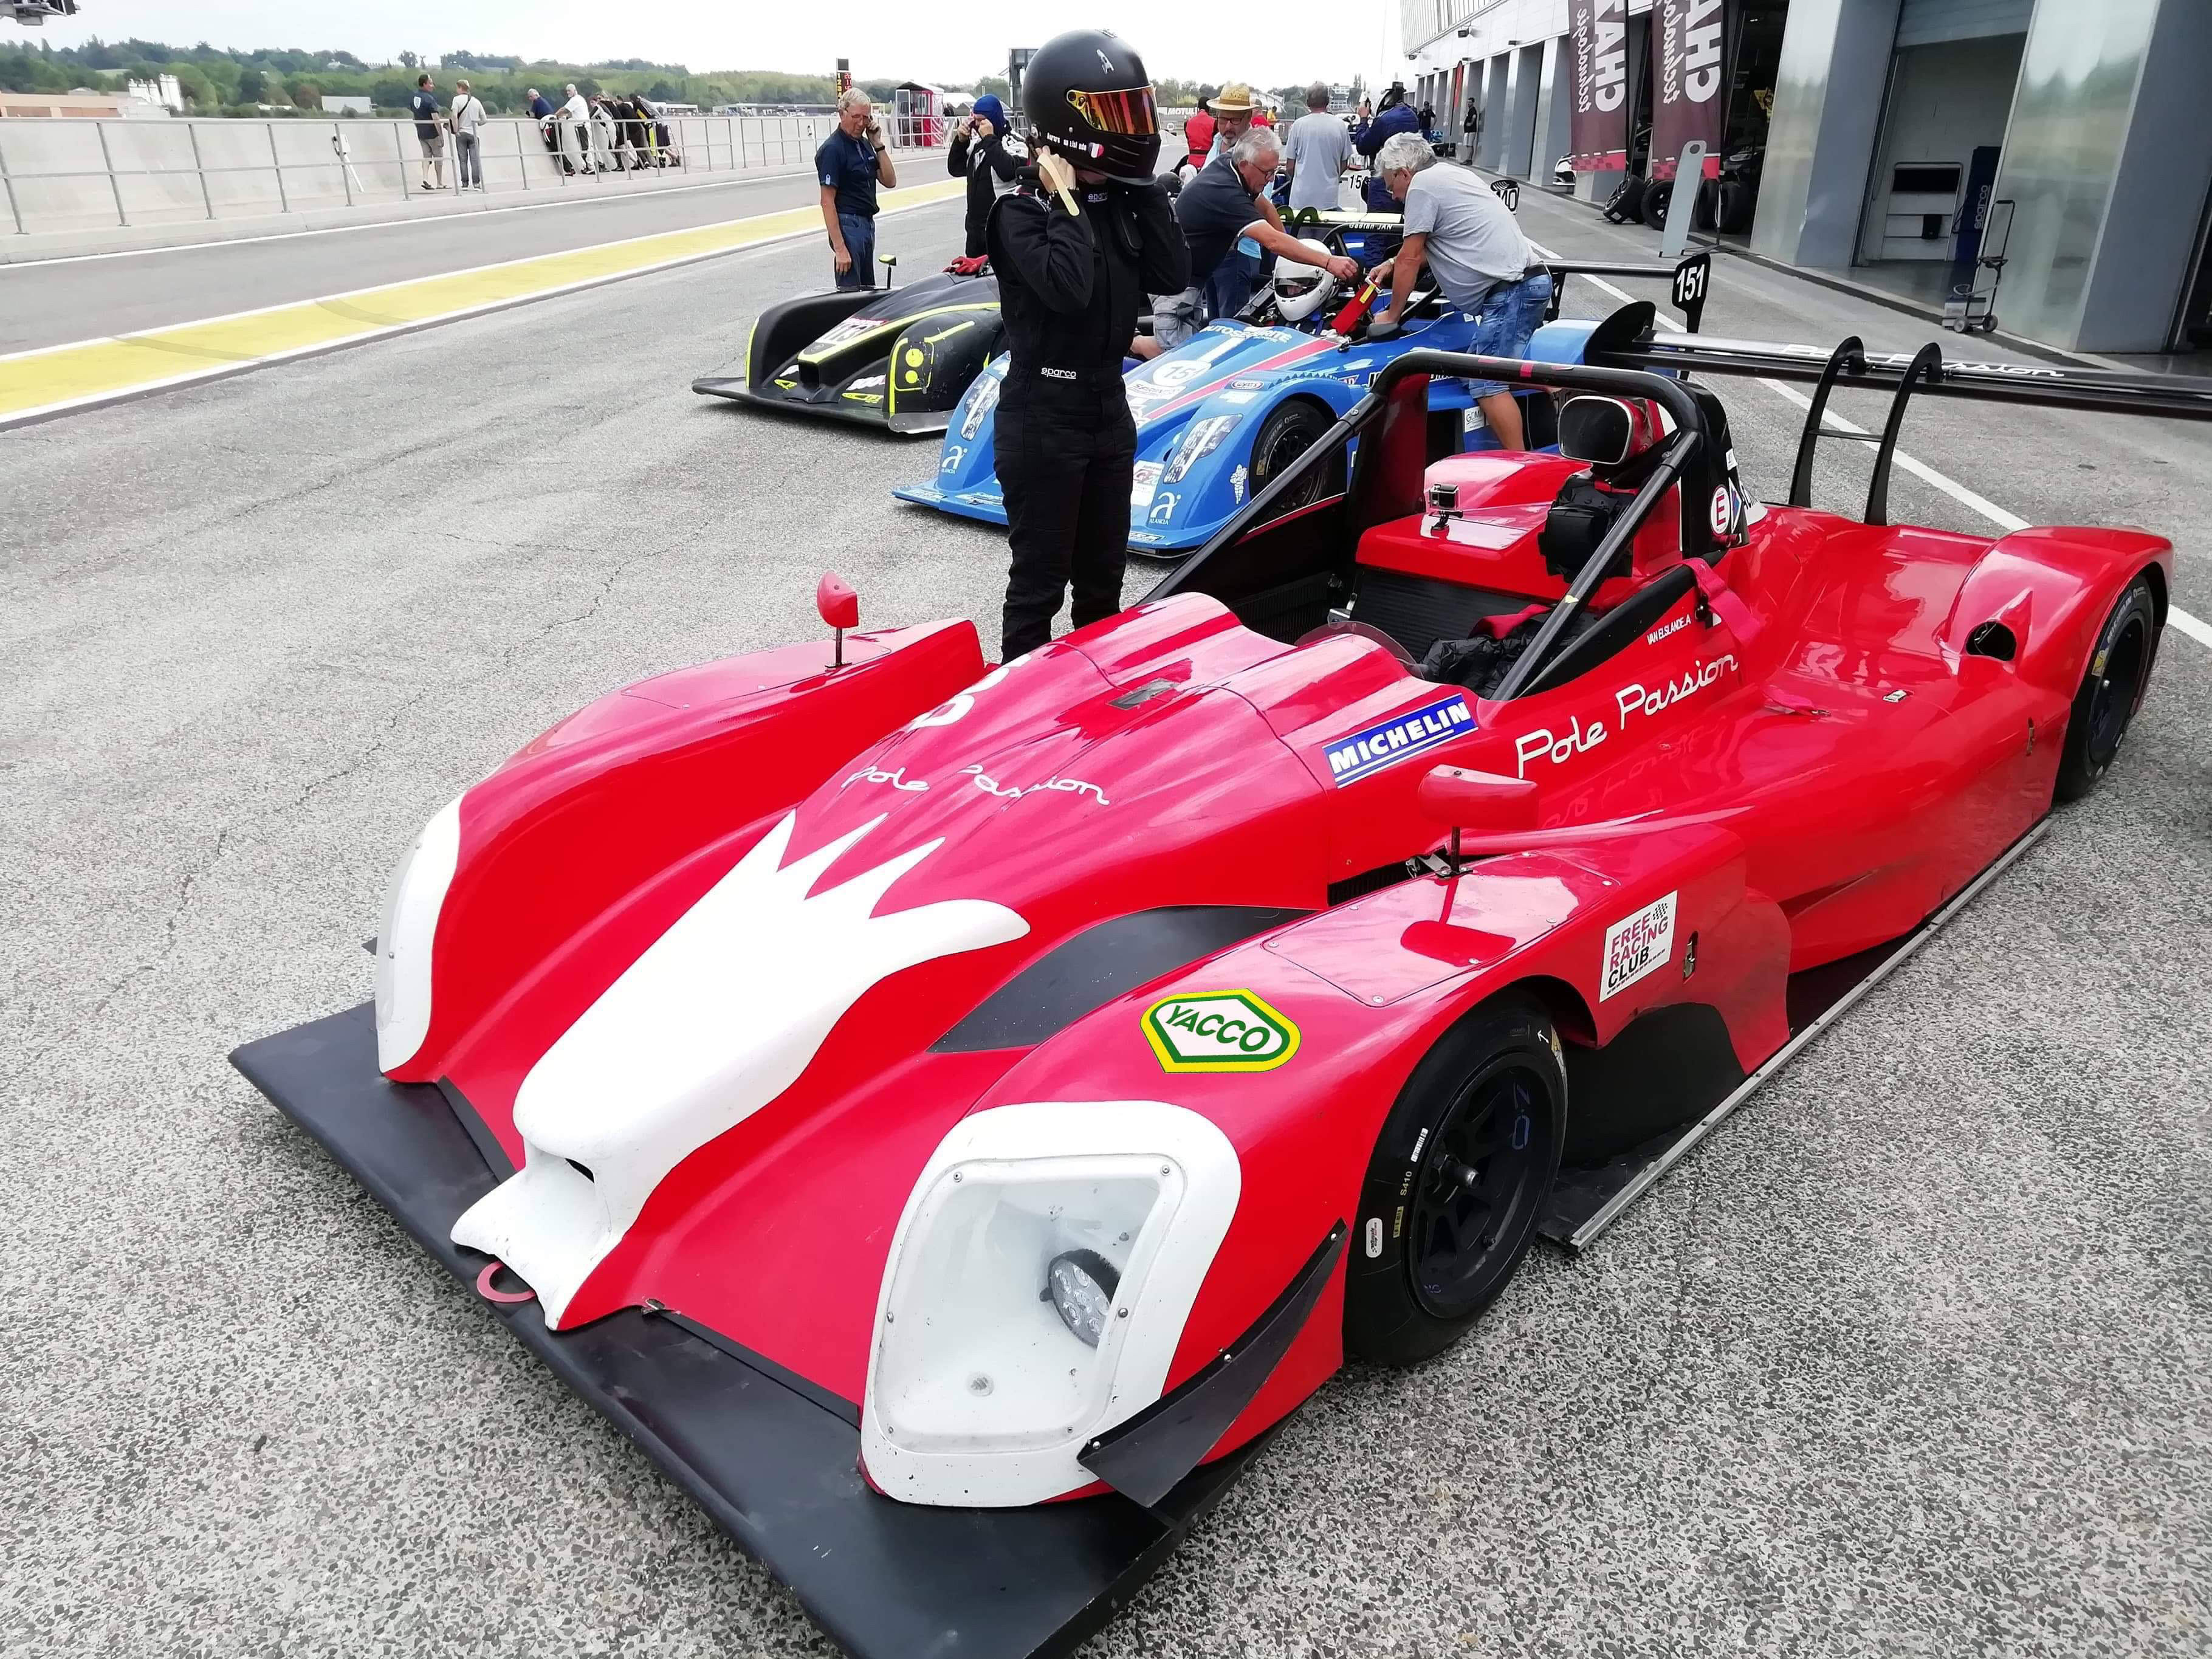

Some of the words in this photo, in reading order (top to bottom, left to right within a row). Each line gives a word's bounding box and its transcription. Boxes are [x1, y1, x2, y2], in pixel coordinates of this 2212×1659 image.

[1974, 185, 1990, 230] sparco
[1677, 264, 1705, 302] 151
[1040, 367, 1077, 379] sparco
[1646, 631, 1658, 645] VAN
[1327, 701, 1471, 774] MICHELIN
[1516, 716, 1608, 779] Pole
[1615, 653, 1739, 730] Passion
[1609, 916, 1668, 972] RACING
[1611, 912, 1651, 955] FREE
[1608, 946, 1649, 988] CLUB
[1166, 1005, 1270, 1053] YACCO
[1400, 1170, 1412, 1197] S410
